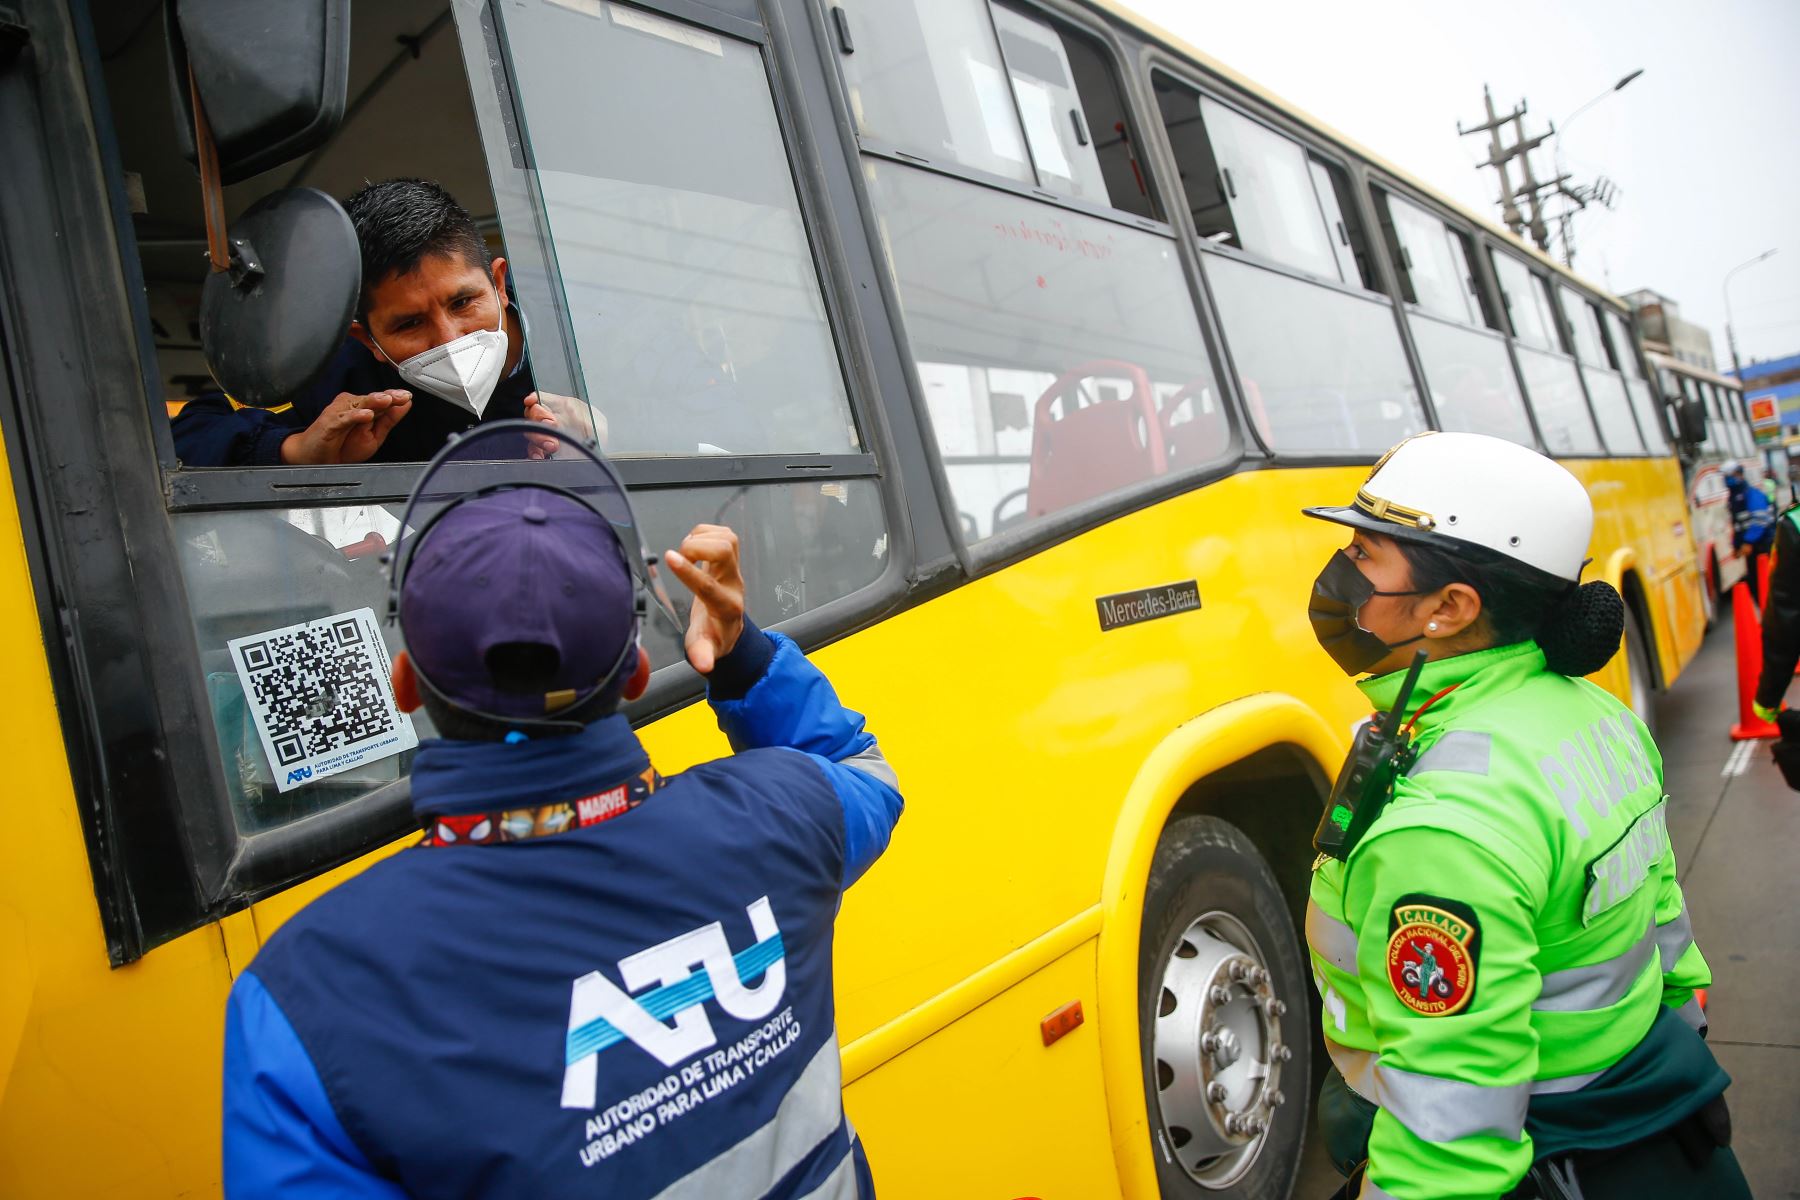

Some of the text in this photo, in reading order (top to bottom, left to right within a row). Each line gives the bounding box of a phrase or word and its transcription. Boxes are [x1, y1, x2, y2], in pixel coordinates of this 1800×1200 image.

[1102, 588, 1199, 626] Mercedes-Benz
[314, 756, 342, 769] AUTORIDAD
[350, 743, 379, 757] TRANSPORTE
[380, 737, 399, 748] URBANO
[316, 766, 329, 775] PARA
[330, 763, 341, 771] LIMA
[346, 755, 364, 765] CALLAO
[286, 766, 313, 785] ATU
[578, 787, 628, 821] MARVEL
[1404, 910, 1462, 937] CALLAO
[1390, 934, 1407, 966] POLICIA
[1406, 927, 1449, 948] NACIONAL
[1448, 944, 1463, 963] DEL
[560, 894, 787, 1110] ATU
[1399, 986, 1447, 1012] TRANSITO
[585, 1006, 794, 1140] AUTORIDAD DE TRANSPORTE
[579, 1021, 801, 1167] URBANO PARA LIMA Y CALLAO
